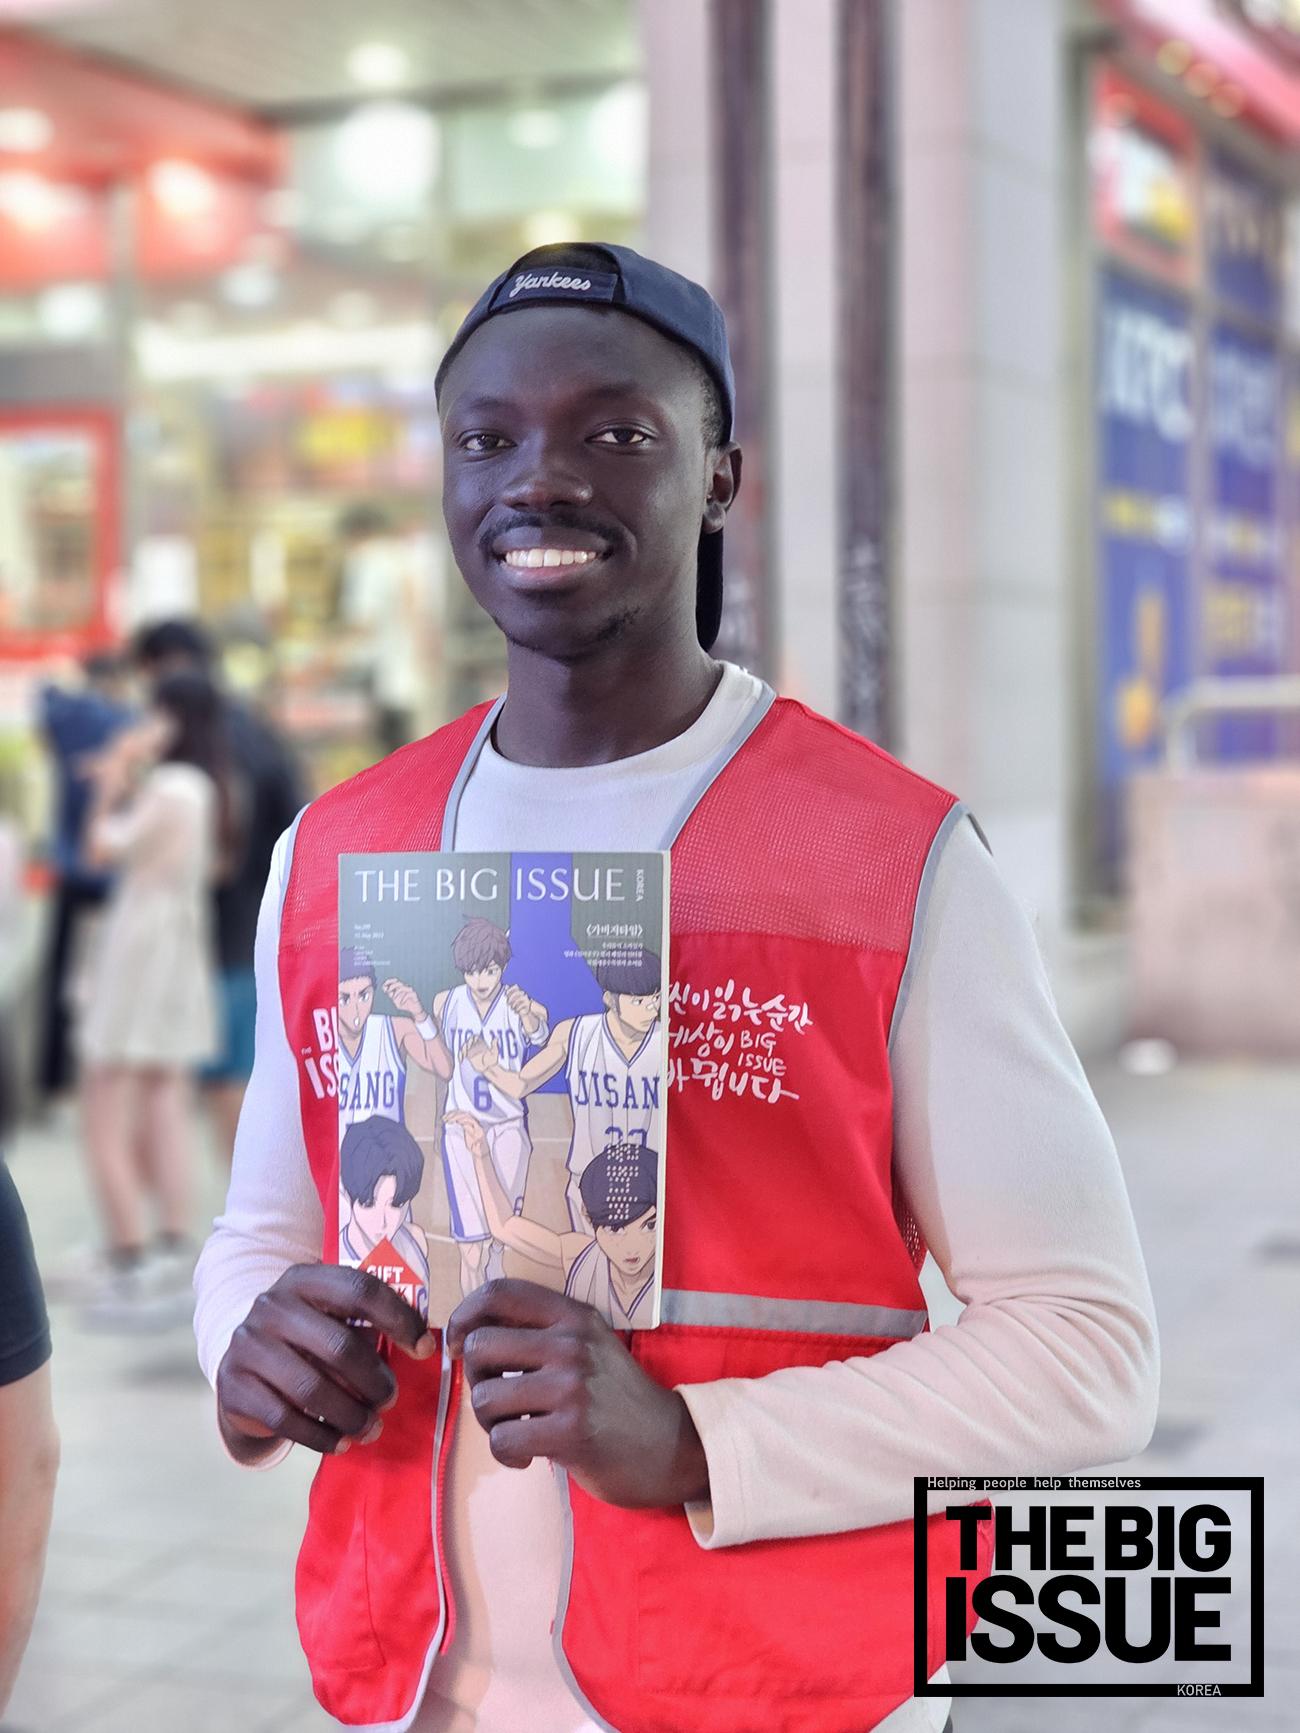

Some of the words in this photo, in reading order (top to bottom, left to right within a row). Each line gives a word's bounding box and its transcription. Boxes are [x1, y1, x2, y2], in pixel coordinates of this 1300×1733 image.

[509, 272, 592, 298] Yankees
[354, 868, 421, 903] THE
[436, 868, 498, 902] BIG
[516, 868, 626, 902] ISSUE
[635, 869, 644, 902] KOREA
[669, 981, 710, 1015] 신이
[761, 994, 814, 1035] 순간
[312, 1006, 339, 1052] BI
[740, 1030, 777, 1057] BIG
[304, 1053, 339, 1099] IS
[738, 1052, 787, 1076] ISSUE
[340, 1071, 395, 1110] SANG
[473, 1075, 492, 1111] 6
[575, 1070, 660, 1109] JISAN
